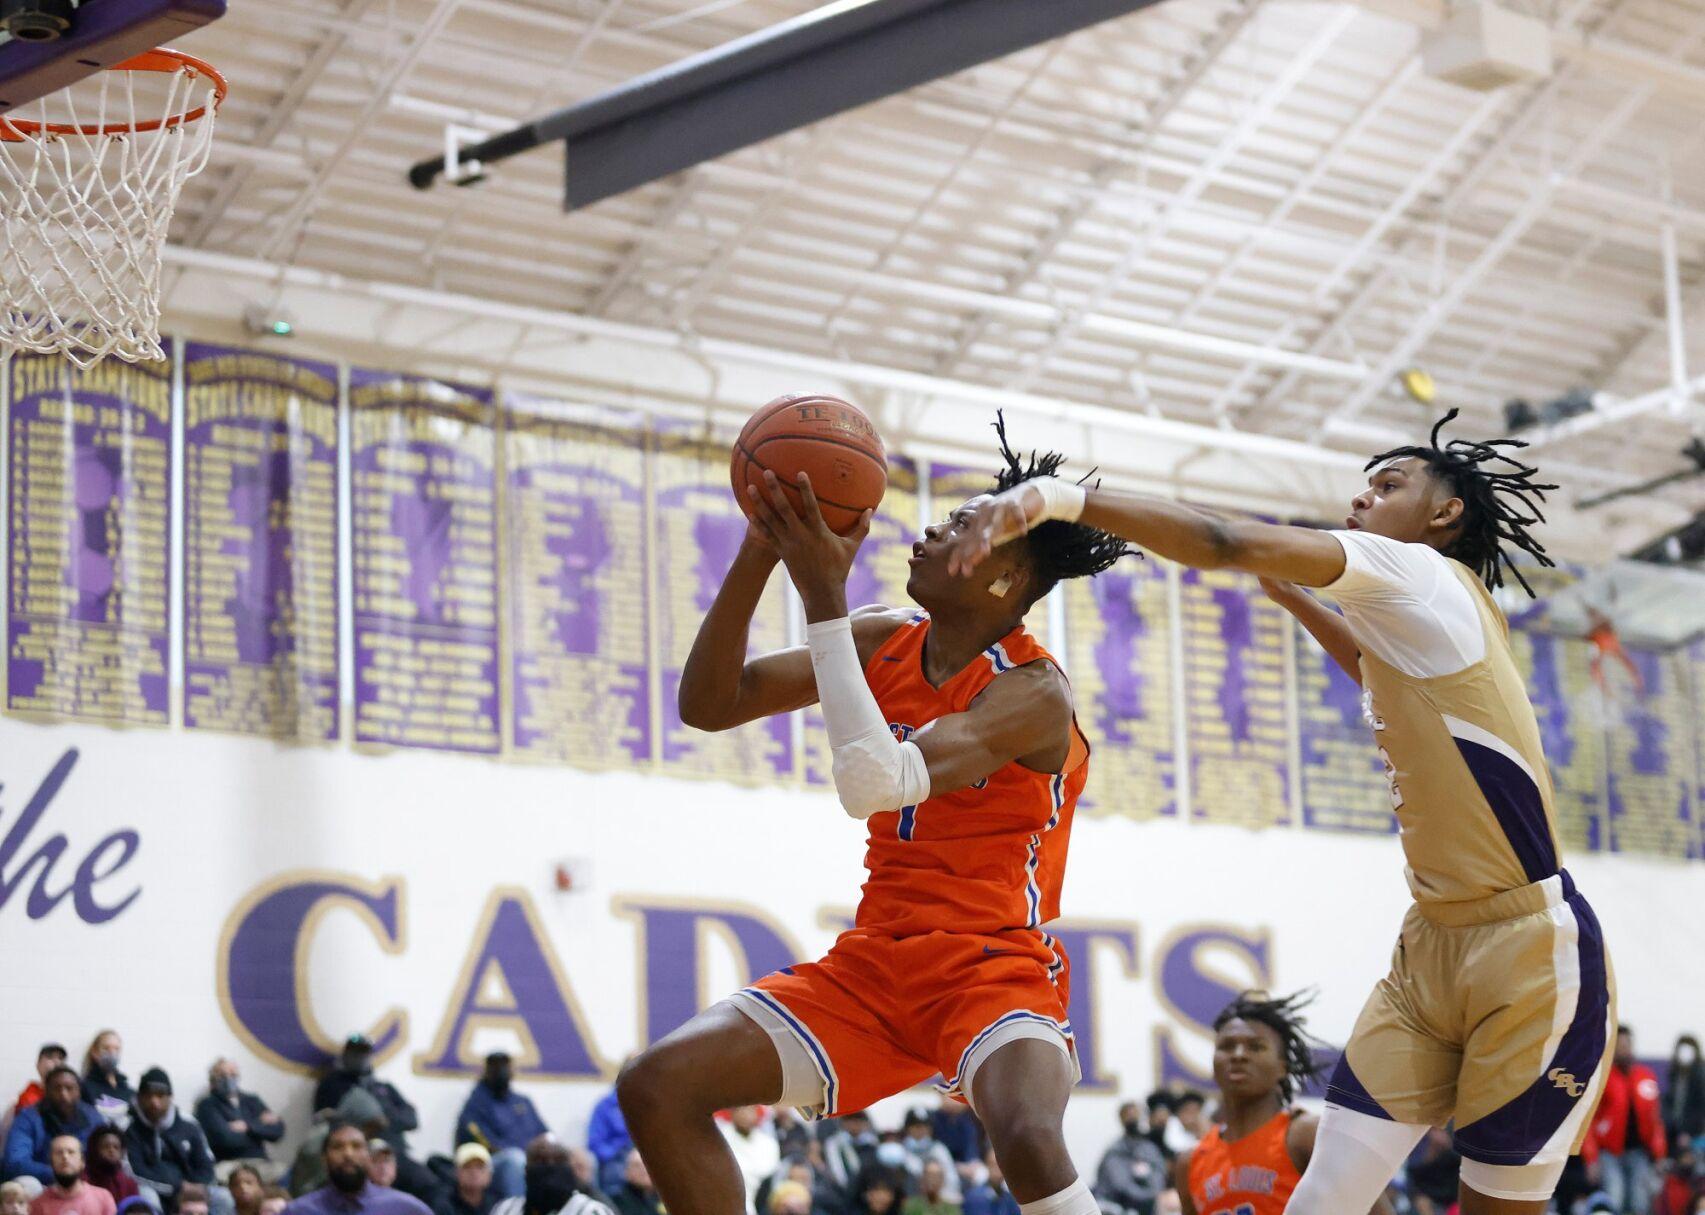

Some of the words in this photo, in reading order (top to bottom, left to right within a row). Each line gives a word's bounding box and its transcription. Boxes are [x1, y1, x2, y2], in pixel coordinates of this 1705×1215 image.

[0, 746, 142, 924] he
[216, 869, 1277, 1096] CADTS
[1547, 1067, 1586, 1098] CBC
